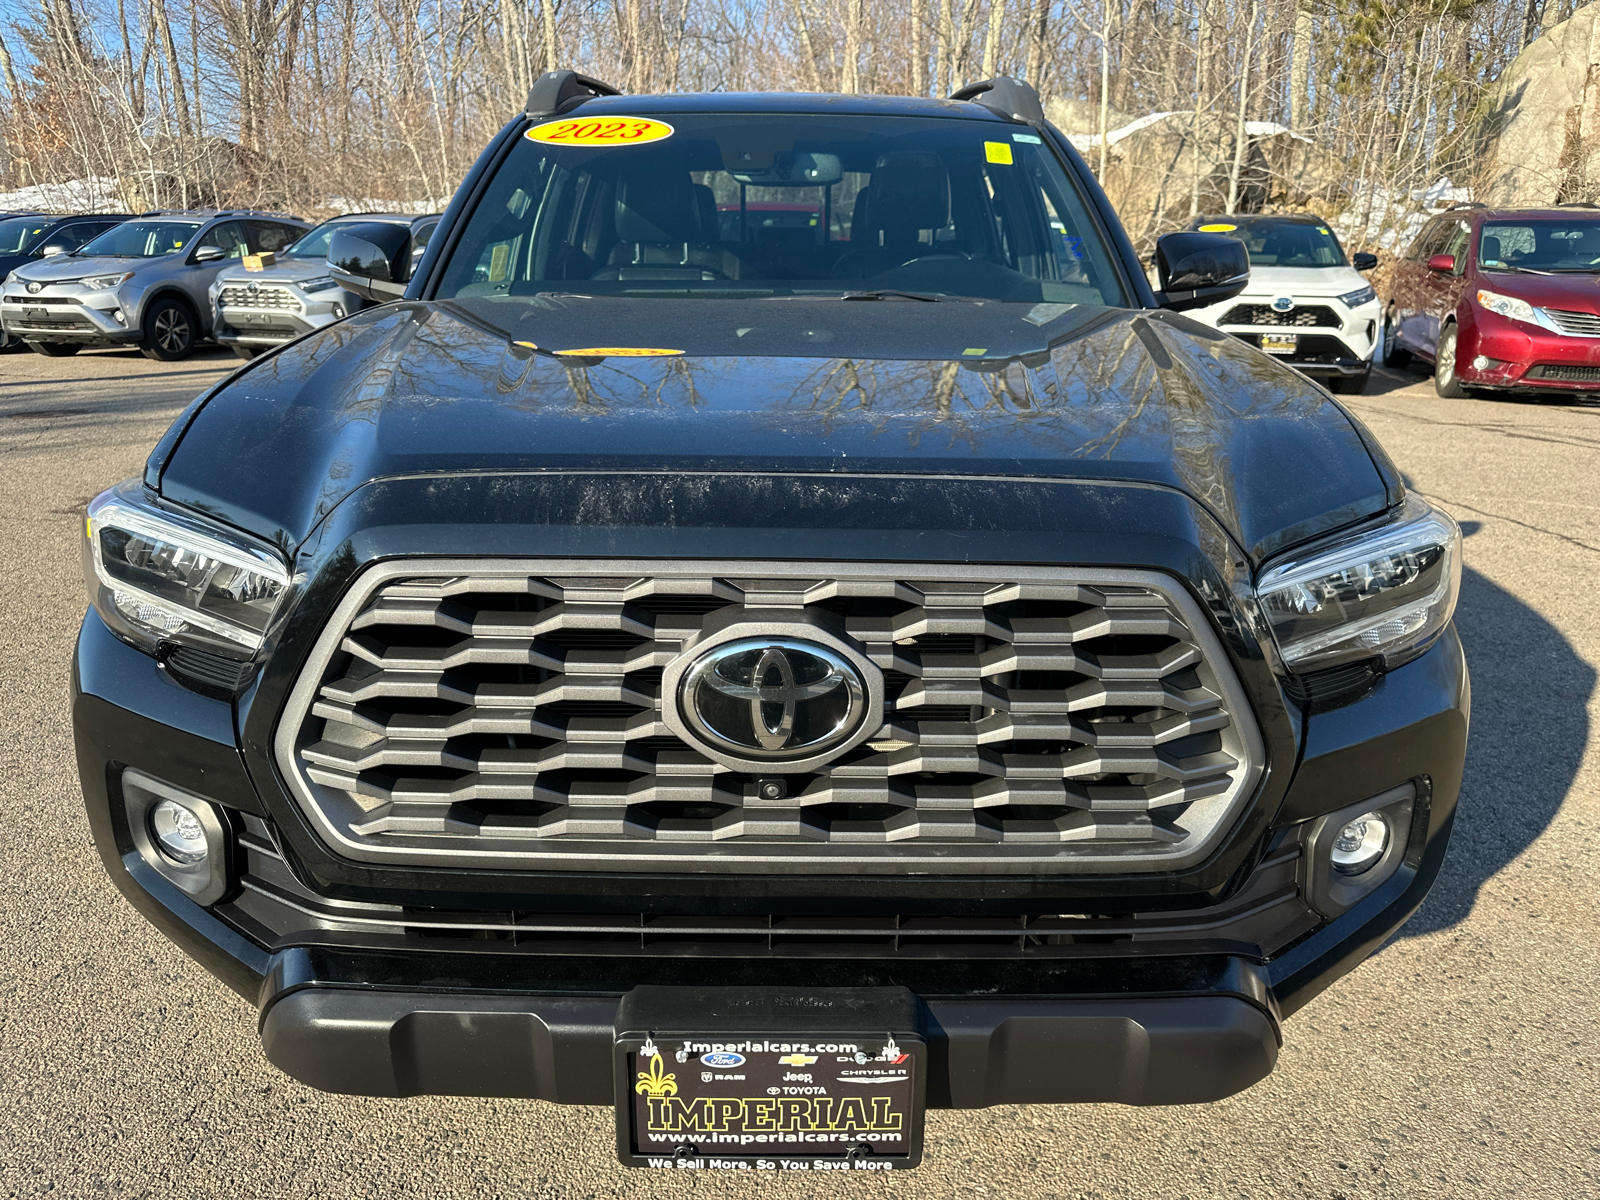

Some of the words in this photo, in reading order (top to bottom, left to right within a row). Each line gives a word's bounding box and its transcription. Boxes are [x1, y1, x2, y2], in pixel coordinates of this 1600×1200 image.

[546, 122, 652, 140] 2023
[683, 1040, 858, 1054] Imperialcars.com
[710, 1054, 736, 1066] Ford
[782, 1071, 813, 1083] Jeep
[782, 1086, 827, 1095] TOYOTA
[647, 1096, 902, 1131] IMPERIAL
[648, 1131, 902, 1145] www.imperialcars.com
[648, 1158, 673, 1169] We
[676, 1158, 704, 1169] Sell
[709, 1159, 752, 1171] More,
[756, 1159, 776, 1170] So
[780, 1159, 809, 1170] You
[813, 1159, 850, 1170] Save
[854, 1159, 893, 1170] More
